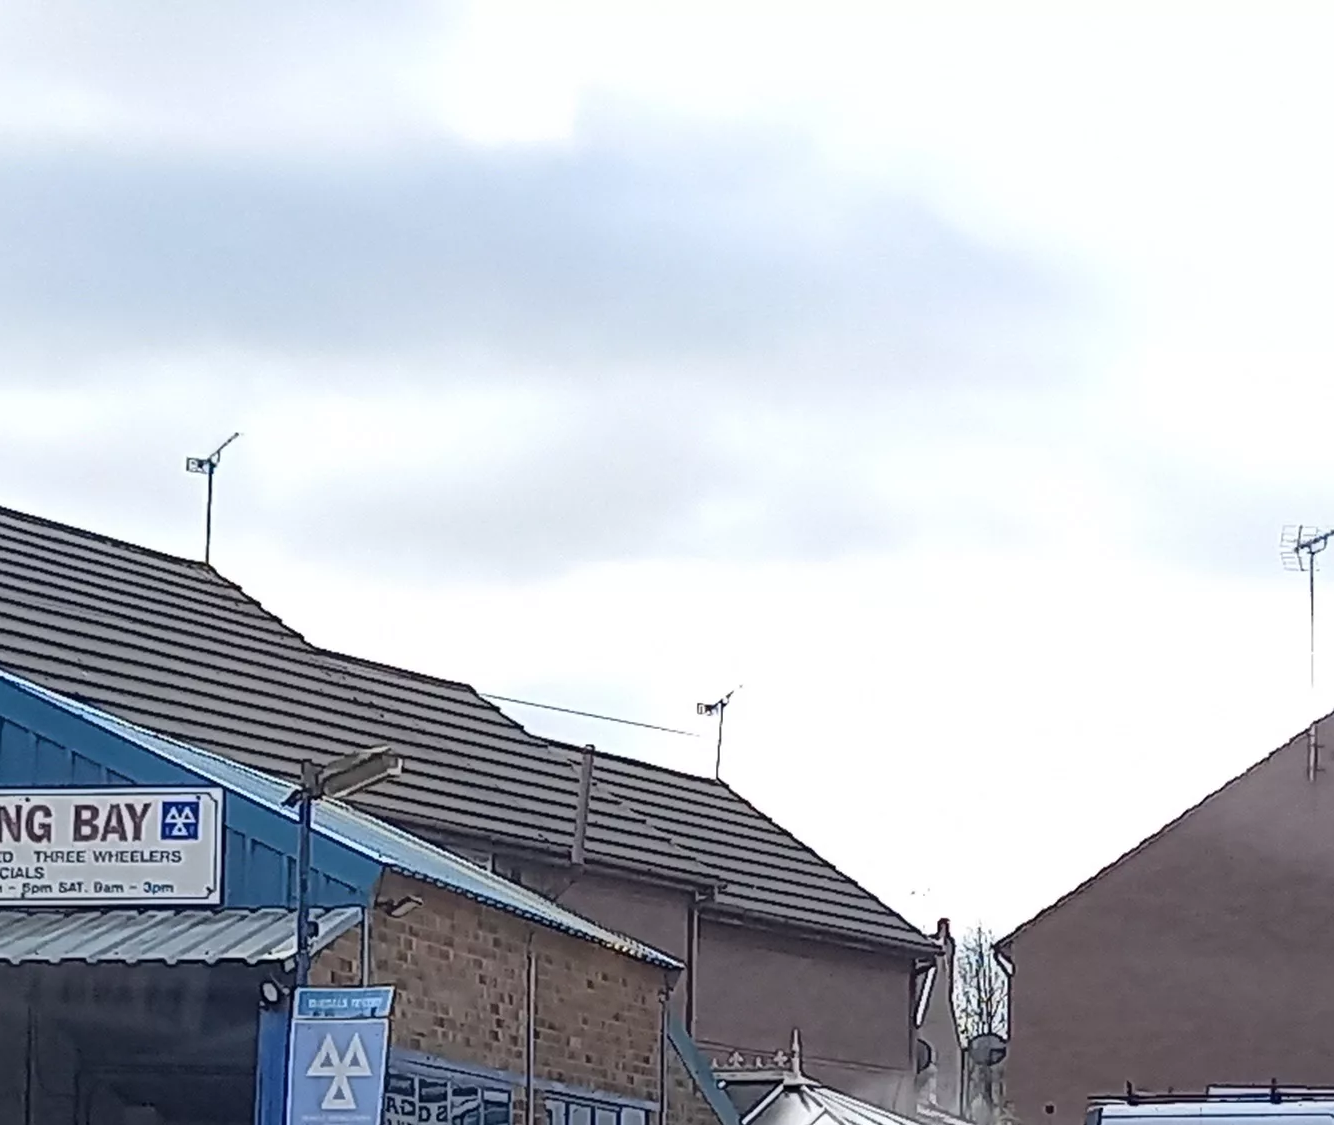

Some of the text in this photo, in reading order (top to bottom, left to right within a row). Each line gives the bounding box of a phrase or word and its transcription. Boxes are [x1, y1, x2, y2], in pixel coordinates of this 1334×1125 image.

[72, 802, 152, 843] BAY
[34, 850, 182, 863] THREE WHEELERS
